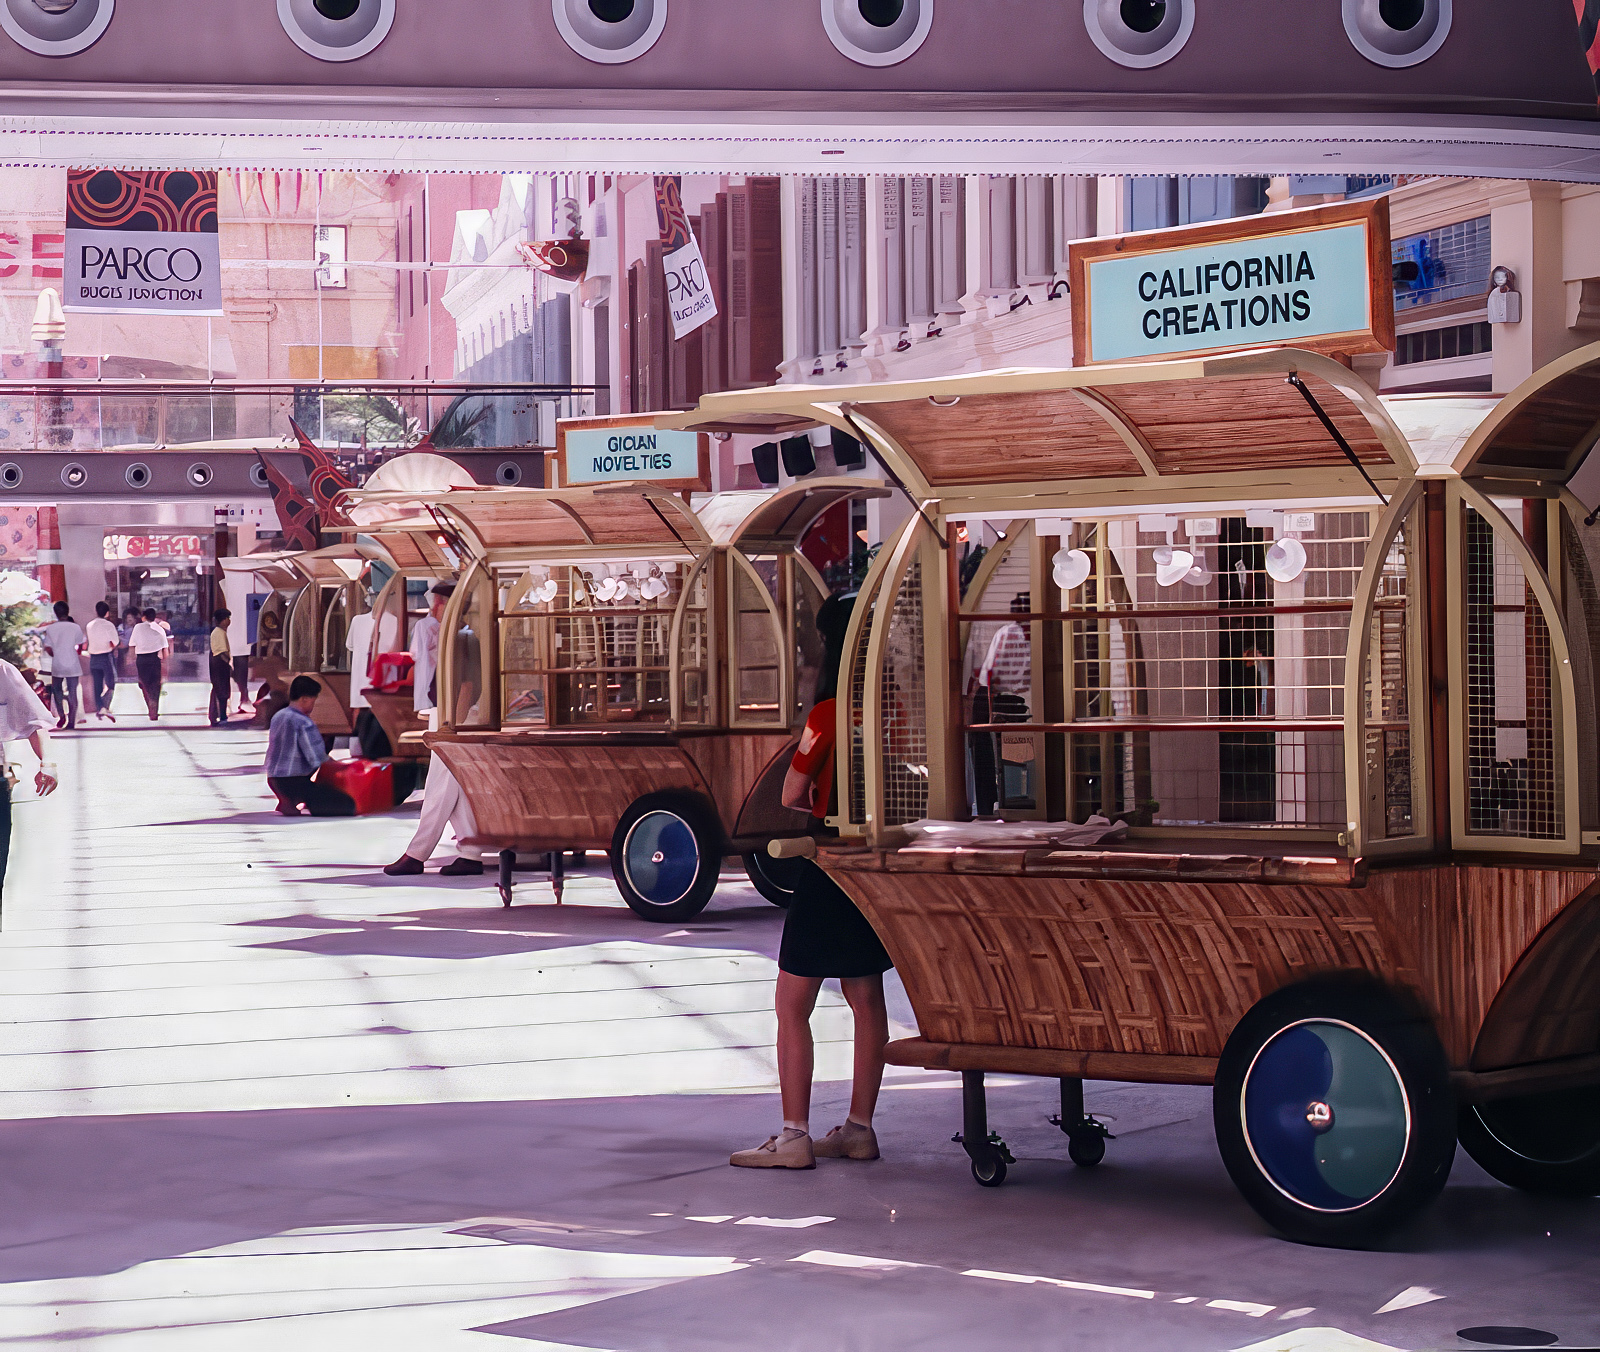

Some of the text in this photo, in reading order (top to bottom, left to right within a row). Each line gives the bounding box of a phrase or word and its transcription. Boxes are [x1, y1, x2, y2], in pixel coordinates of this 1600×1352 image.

[81, 245, 202, 282] PARCO
[1138, 250, 1316, 302] CALIFORNIA
[1142, 289, 1311, 340] CREATIONS
[592, 453, 672, 473] NOVELTIES
